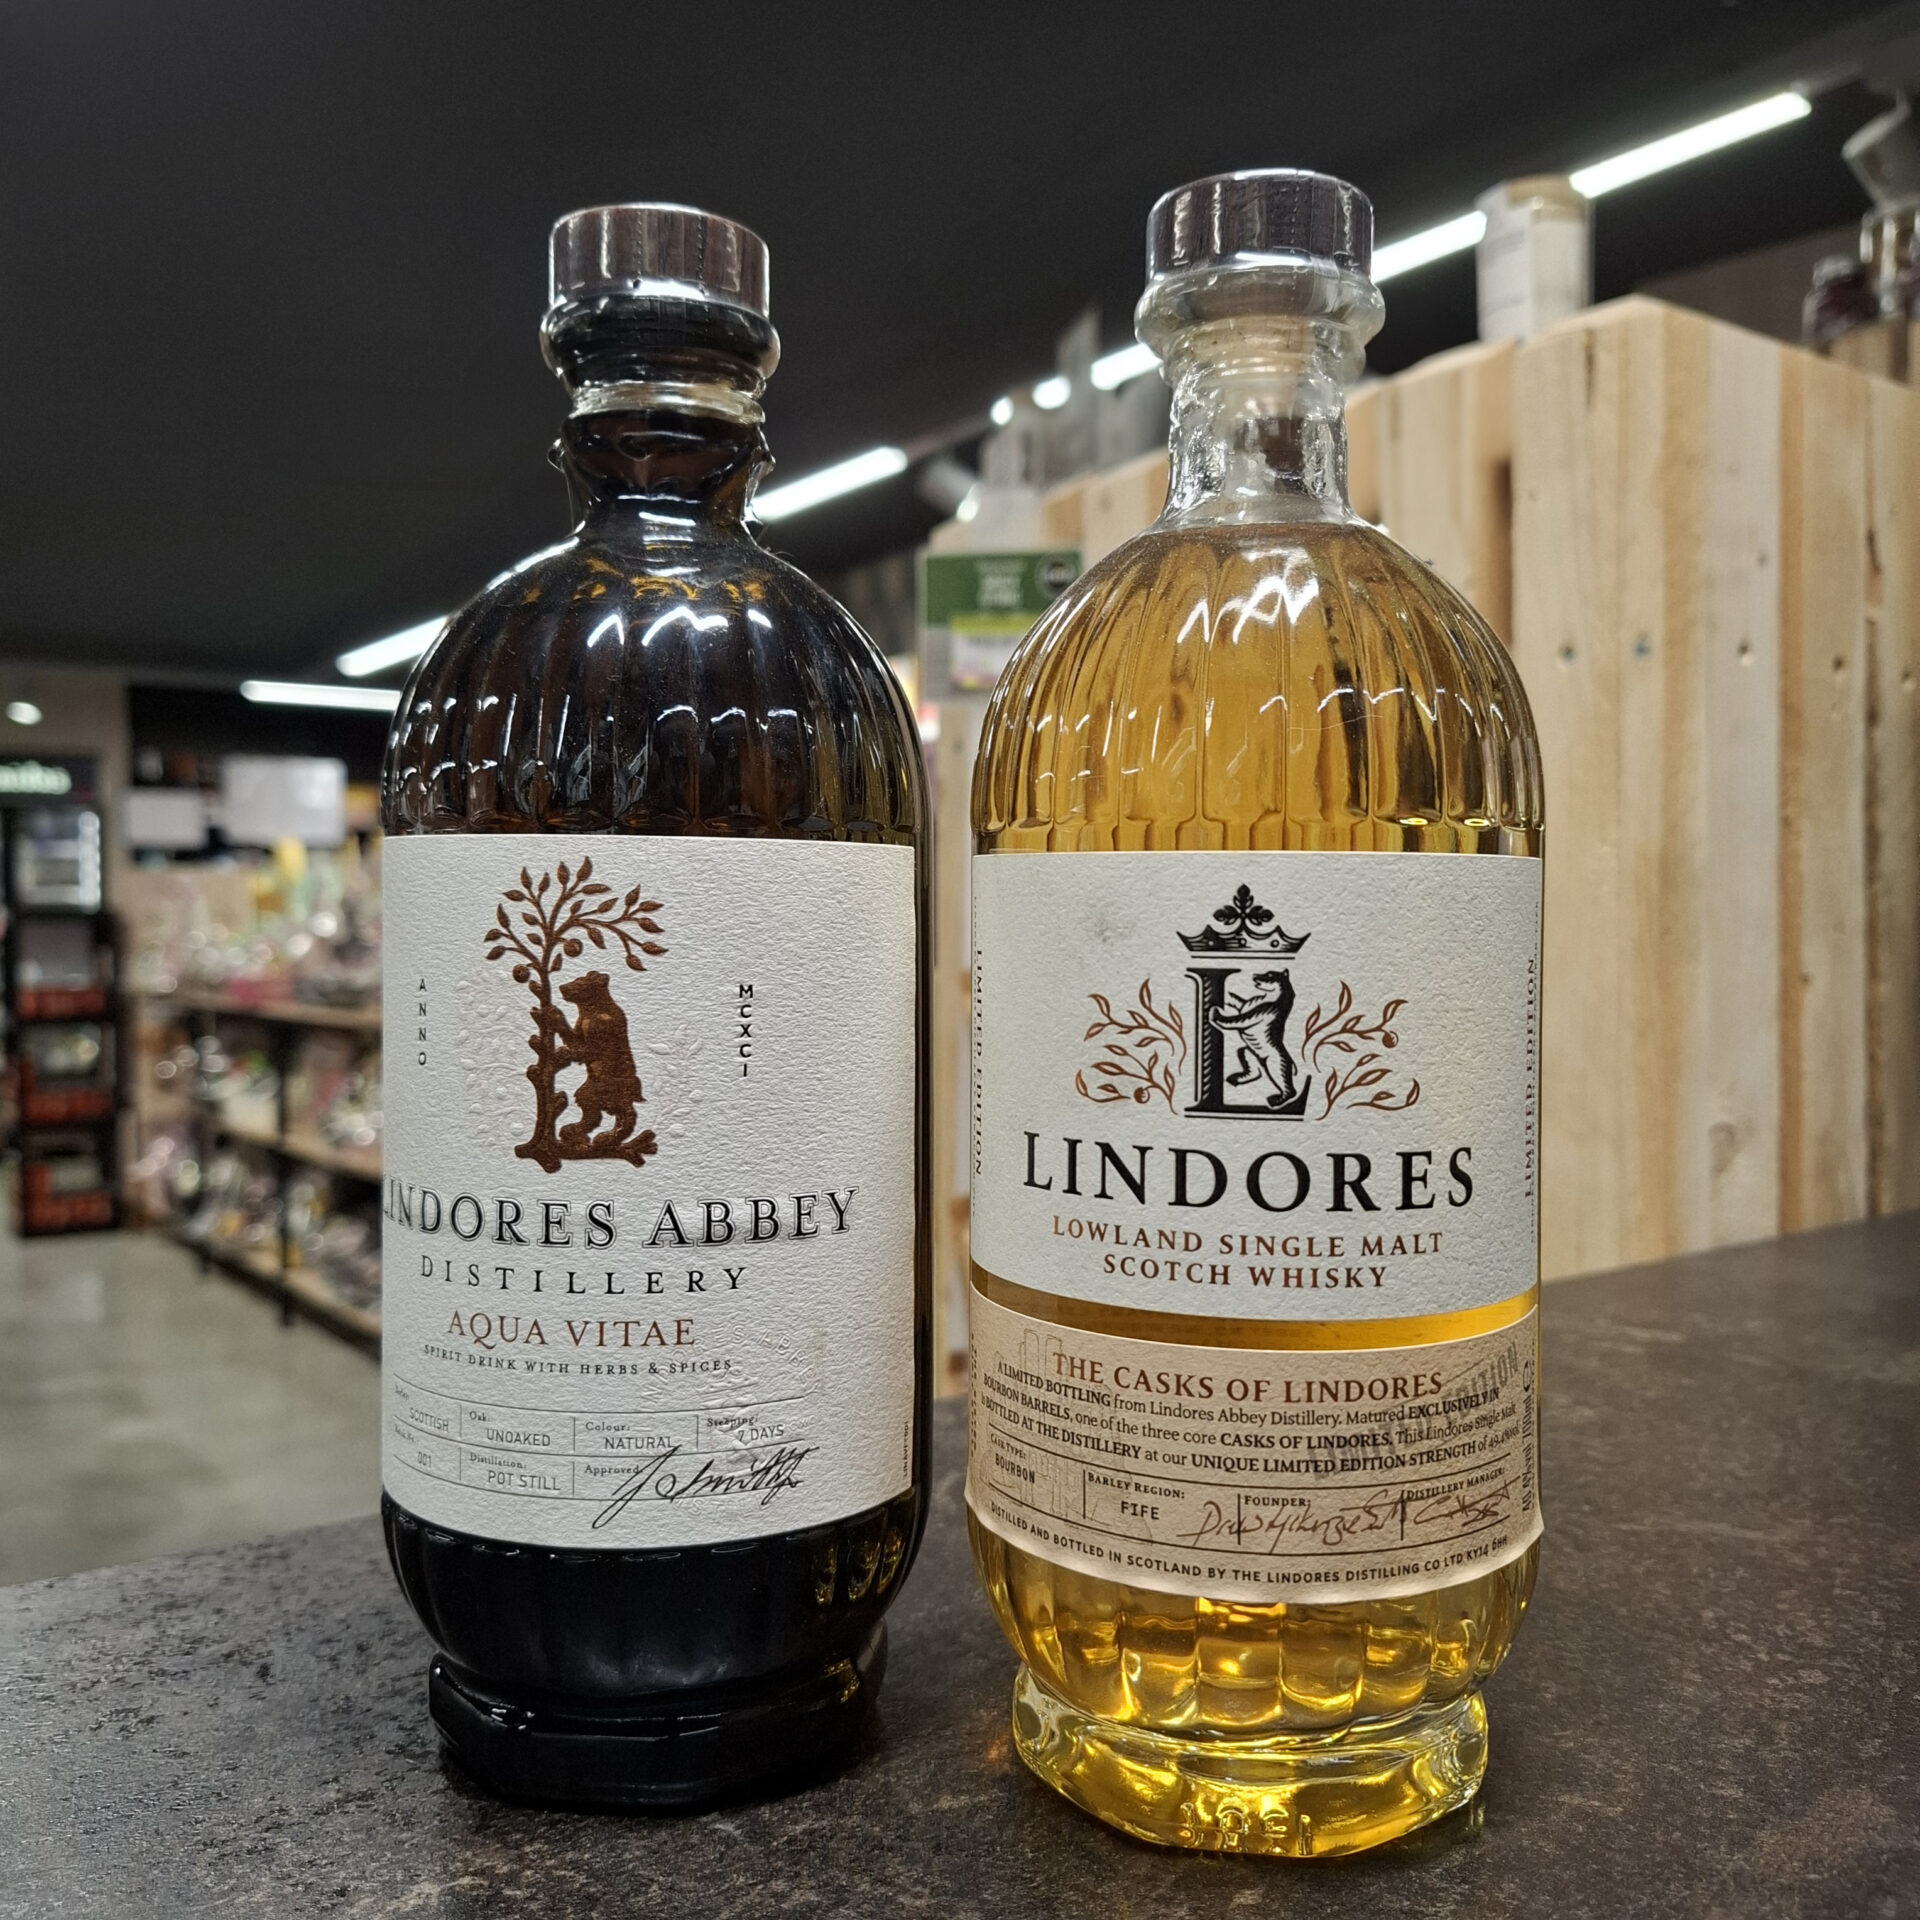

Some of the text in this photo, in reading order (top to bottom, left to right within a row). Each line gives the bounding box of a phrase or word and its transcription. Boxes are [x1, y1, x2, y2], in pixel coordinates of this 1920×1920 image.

[418, 977, 428, 1067] ANNO
[738, 984, 754, 1078] MCXCI
[1023, 1130, 1475, 1213] LINDORES
[641, 1185, 860, 1249] ABBEY
[1052, 1214, 1444, 1259] LOWLAND SINGLE MALT
[420, 1254, 747, 1295] DISTILLERY
[1102, 1253, 1388, 1289] SCOTCH WHISKY
[447, 1309, 696, 1350] AQUA VITAE
[423, 1343, 734, 1376] SPIRIT DRINK WITH HERBS & SPICES
[1052, 1351, 1442, 1403] THE CASKS OF LINDORES
[983, 1372, 1020, 1402] BOURBON
[1021, 1392, 1073, 1422] BARRELS,
[1075, 1412, 1098, 1427] one
[1100, 1415, 1115, 1431] of
[1116, 1418, 1139, 1435] the
[1141, 1422, 1181, 1441] three
[1183, 1432, 1217, 1446] core
[1220, 1432, 1276, 1449] CASKS
[1279, 1436, 1303, 1450] OF
[1306, 1432, 1393, 1450] LINDORES.
[1395, 1428, 1424, 1445] This
[1426, 1419, 1473, 1440] Lindores
[1475, 1409, 1501, 1430] Single
[1003, 1362, 1044, 1389] LIMITED
[1046, 1378, 1112, 1407] BOTTLING
[1113, 1394, 1146, 1414] from
[1150, 1399, 1214, 1422] Lindores
[1217, 1406, 1267, 1427] Abbey
[1271, 1409, 1343, 1429] Distillery.
[1346, 1407, 1405, 1426] Matured
[1408, 1389, 1488, 1420] EXCLUSIVELY
[409, 1406, 450, 1432] SCOTTISH
[485, 1427, 551, 1447] UNOAKED
[750, 1424, 784, 1442] DAYS
[986, 1398, 1020, 1425] BOTTLED
[1020, 1416, 1035, 1432] AT
[1036, 1420, 1060, 1440] THE
[1061, 1430, 1142, 1460] DISTILLERY
[1144, 1448, 1159, 1462] at
[1162, 1453, 1188, 1466] our
[1192, 1453, 1260, 1474] UNIQUE
[1263, 1458, 1336, 1474] LIMITED
[1340, 1455, 1406, 1473] EDITION
[1408, 1440, 1477, 1467] STRENGTH
[1477, 1434, 1488, 1451] of
[603, 1435, 676, 1450] NATURAL
[487, 1469, 562, 1492] POT STILL
[994, 1452, 1036, 1484] BOURBON
[1088, 1471, 1186, 1500] BARLEY REGION:
[1243, 1494, 1312, 1508] FOUNDER:
[1406, 1479, 1465, 1501] DISTILLERY
[1119, 1500, 1160, 1521] FIFE
[991, 1501, 1028, 1531] DISTILLED
[1030, 1524, 1050, 1541] AND
[1053, 1532, 1105, 1559] BOTTLED
[1108, 1550, 1123, 1564] IN
[1126, 1554, 1202, 1578] SCOTLAND
[1207, 1567, 1227, 1579] BY
[1231, 1568, 1261, 1582] THE
[1266, 1570, 1341, 1584] LINDORES
[1345, 1562, 1421, 1583] DISTILLING
[1424, 1559, 1441, 1573] CO
[1444, 1553, 1464, 1569] LTD
[1466, 1543, 1490, 1563] KY14
